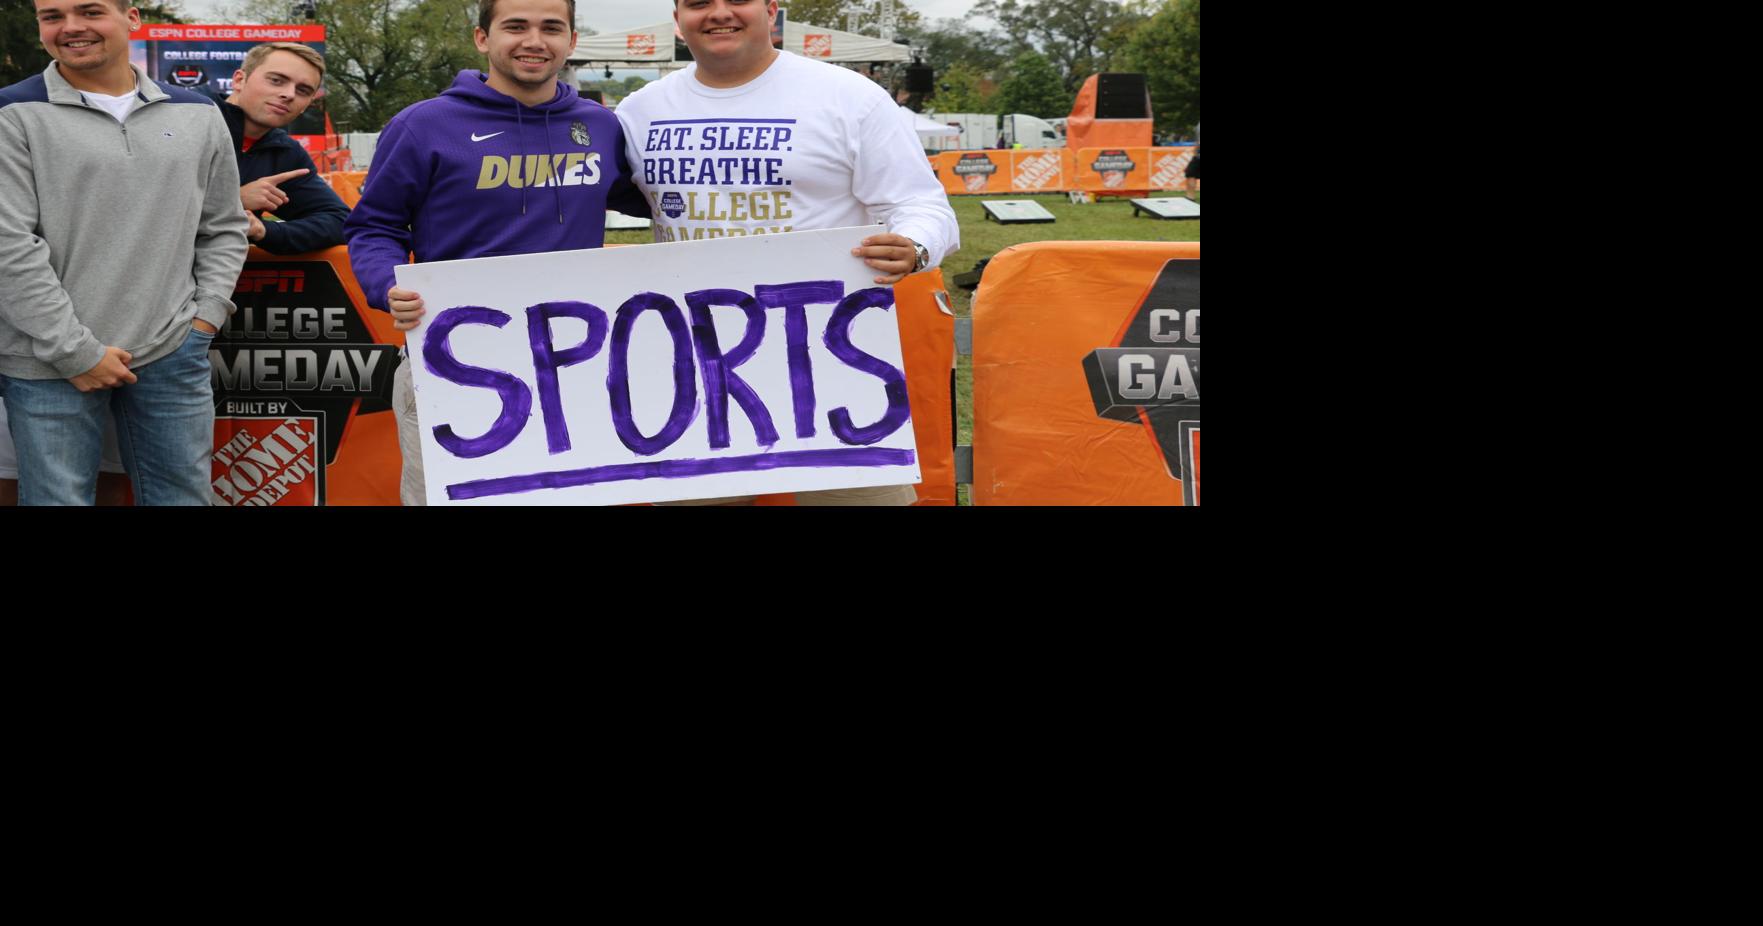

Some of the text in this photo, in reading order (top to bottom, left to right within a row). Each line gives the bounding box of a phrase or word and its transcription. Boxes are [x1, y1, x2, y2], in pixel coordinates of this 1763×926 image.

[149, 28, 302, 38] ESPN COLLEGE GAMEDAY
[164, 51, 247, 61] COLLEGE FOOTB
[645, 126, 793, 152] EAT. SLEEP.
[475, 152, 601, 190] DUKES
[643, 157, 792, 186] BREATHE.
[235, 270, 305, 293] SPN
[222, 307, 347, 339] LLEGE
[208, 349, 382, 392] MEDAY
[423, 280, 911, 458] SPORTS
[226, 401, 288, 415] BUILT BY
[212, 428, 257, 466] THE
